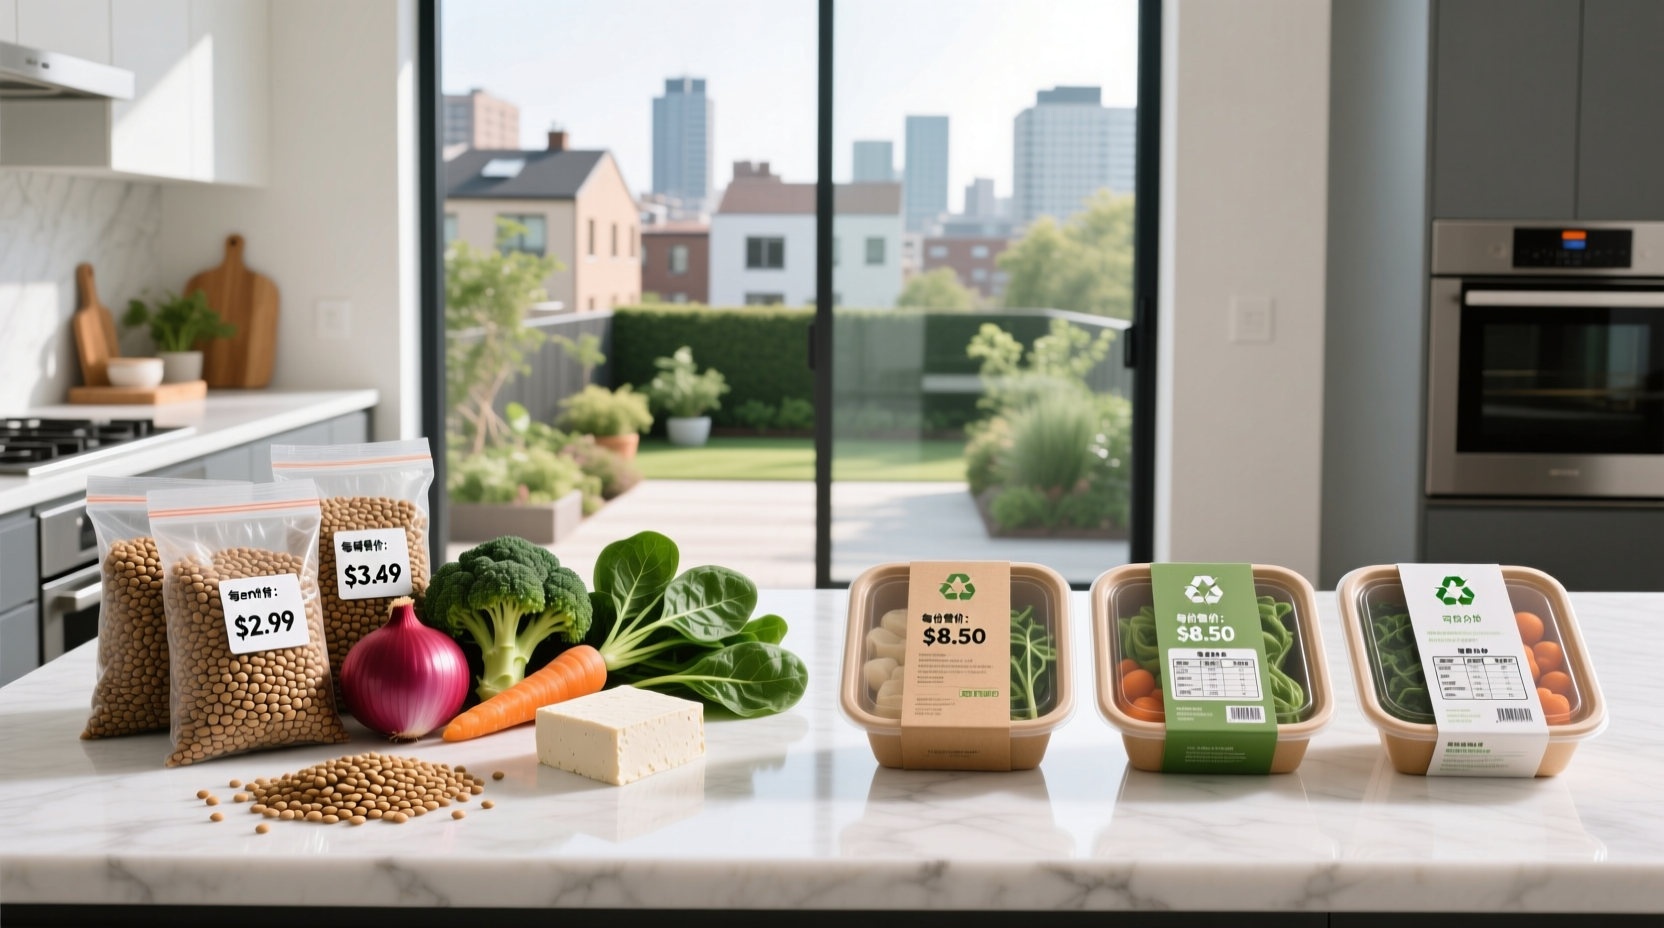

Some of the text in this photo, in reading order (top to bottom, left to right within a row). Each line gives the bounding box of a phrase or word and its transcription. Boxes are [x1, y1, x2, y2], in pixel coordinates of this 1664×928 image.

[344, 563, 402, 589] $3.49
[234, 610, 294, 641] $2.99
[922, 626, 986, 647] $8.50
[1176, 625, 1235, 642] $8.50
